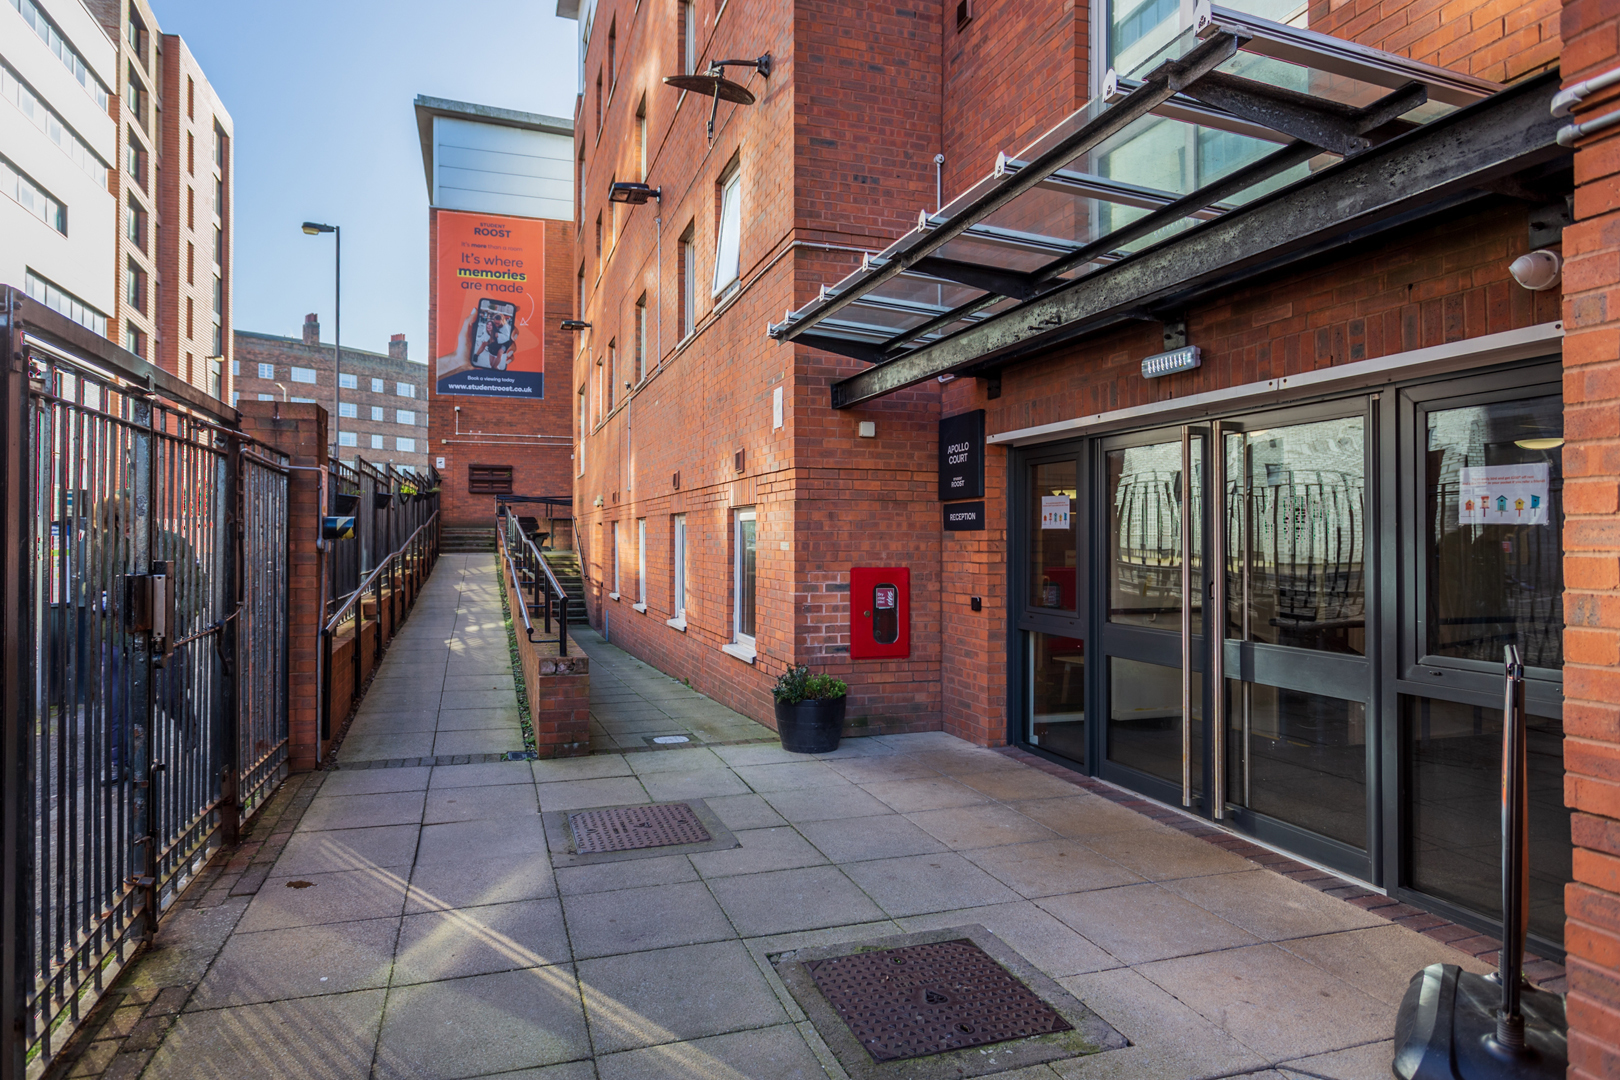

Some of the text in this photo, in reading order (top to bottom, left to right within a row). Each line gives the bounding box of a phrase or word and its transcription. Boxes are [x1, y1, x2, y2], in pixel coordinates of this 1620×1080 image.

[474, 227, 511, 238] ROOST
[461, 252, 524, 268] It's where
[458, 268, 526, 281] memories
[461, 281, 523, 294] are made
[448, 383, 532, 393] www.studentroost.co.uk
[947, 442, 970, 454] APOLLO
[948, 453, 968, 464] COURT
[951, 480, 965, 488] ROOST
[949, 512, 976, 521] RECEPTION
